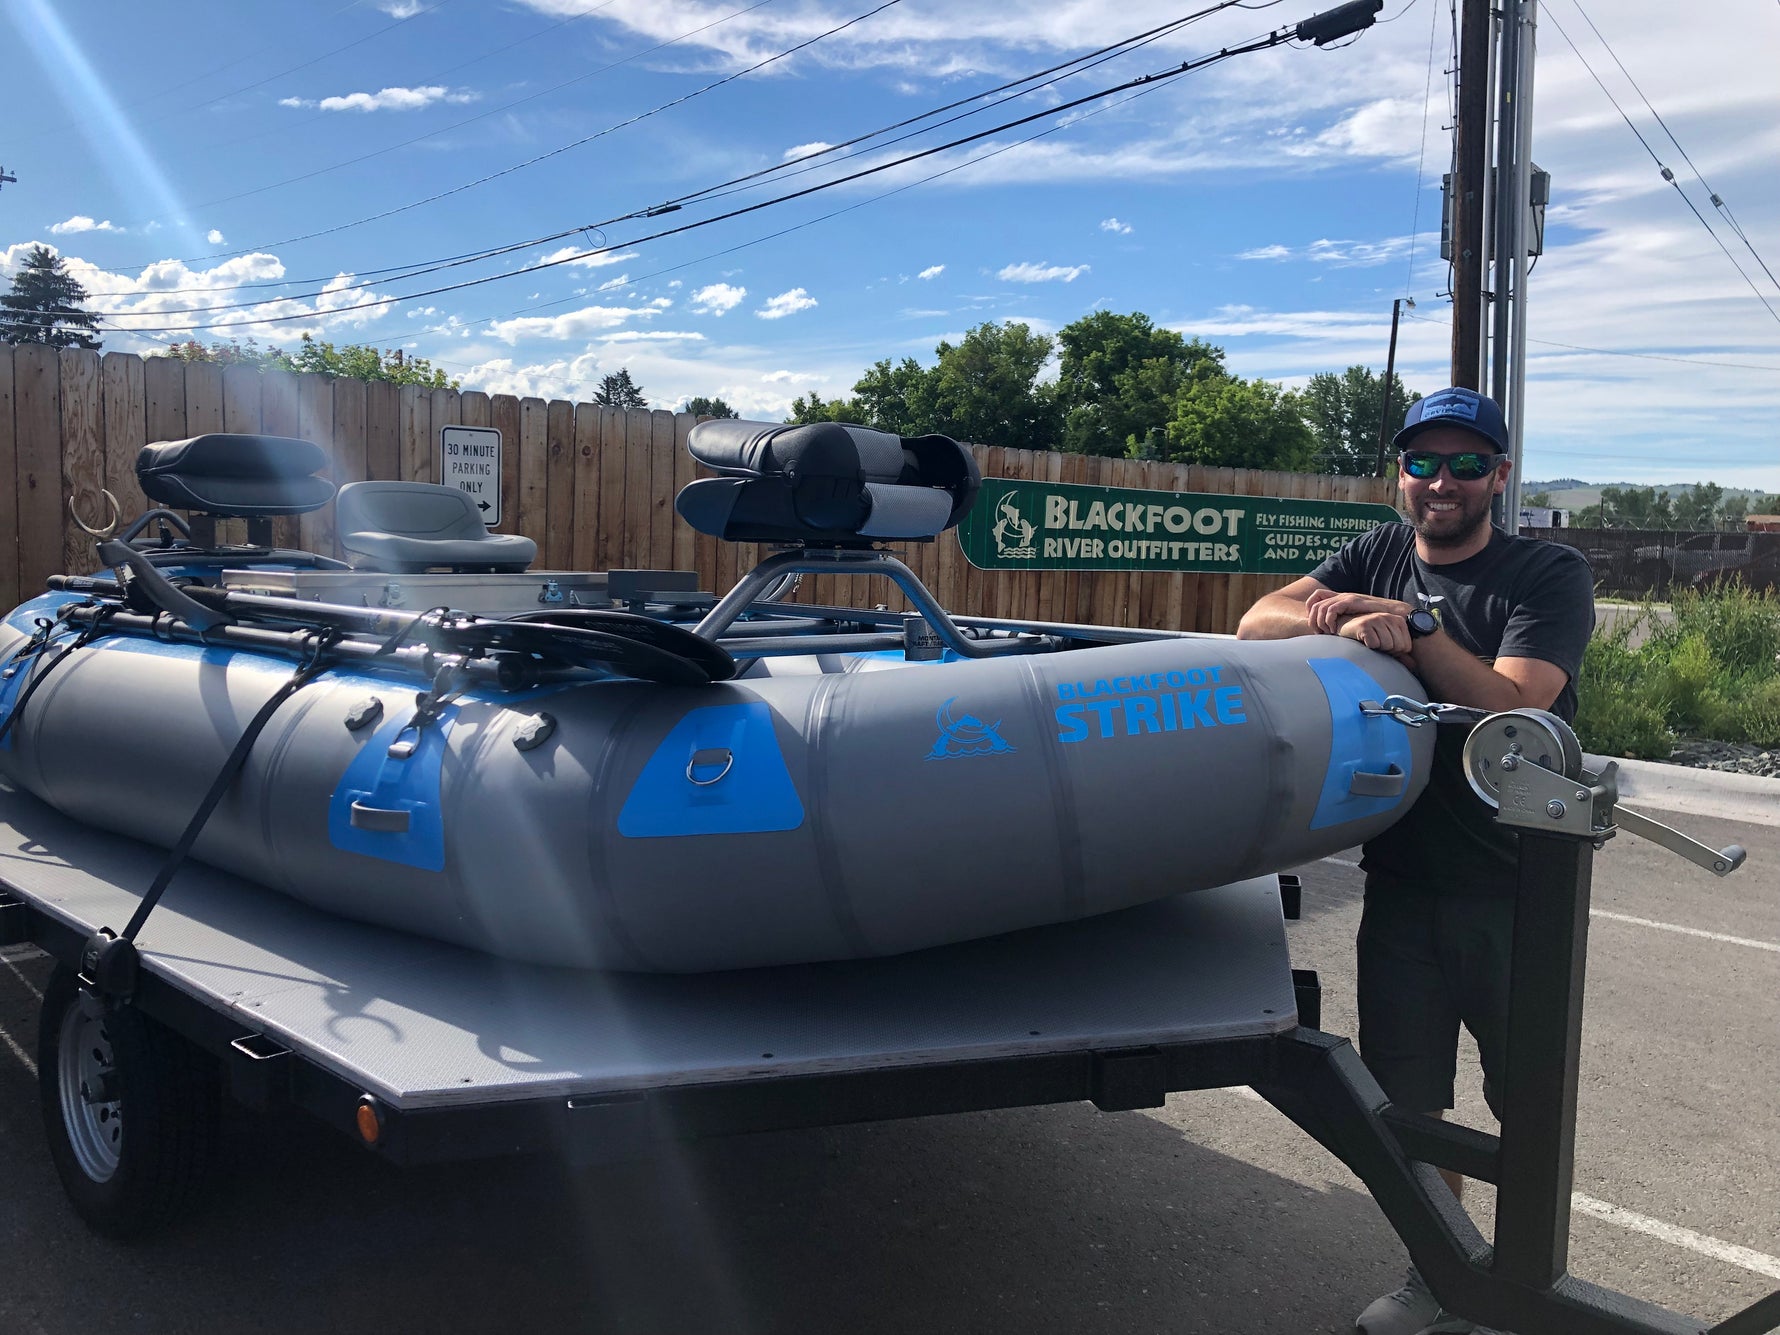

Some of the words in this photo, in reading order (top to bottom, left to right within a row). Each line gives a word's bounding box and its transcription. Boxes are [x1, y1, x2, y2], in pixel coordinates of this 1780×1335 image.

[447, 443, 459, 455] 30
[462, 444, 495, 457] MINUTE
[452, 462, 491, 475] PARKING
[460, 481, 483, 493] ONLY
[1044, 495, 1245, 537] BLACKFOOT
[1255, 513, 1277, 526] FLY
[1279, 515, 1325, 528] FISHING
[1330, 517, 1380, 530] INSPIRED
[1330, 536, 1349, 548] GE
[1043, 538, 1105, 559] RIVER
[1107, 539, 1240, 562] OUTFITTERS
[1263, 547, 1299, 560] AND
[1057, 665, 1224, 700] BLACKFOOT
[1054, 685, 1248, 743] STRIKE
